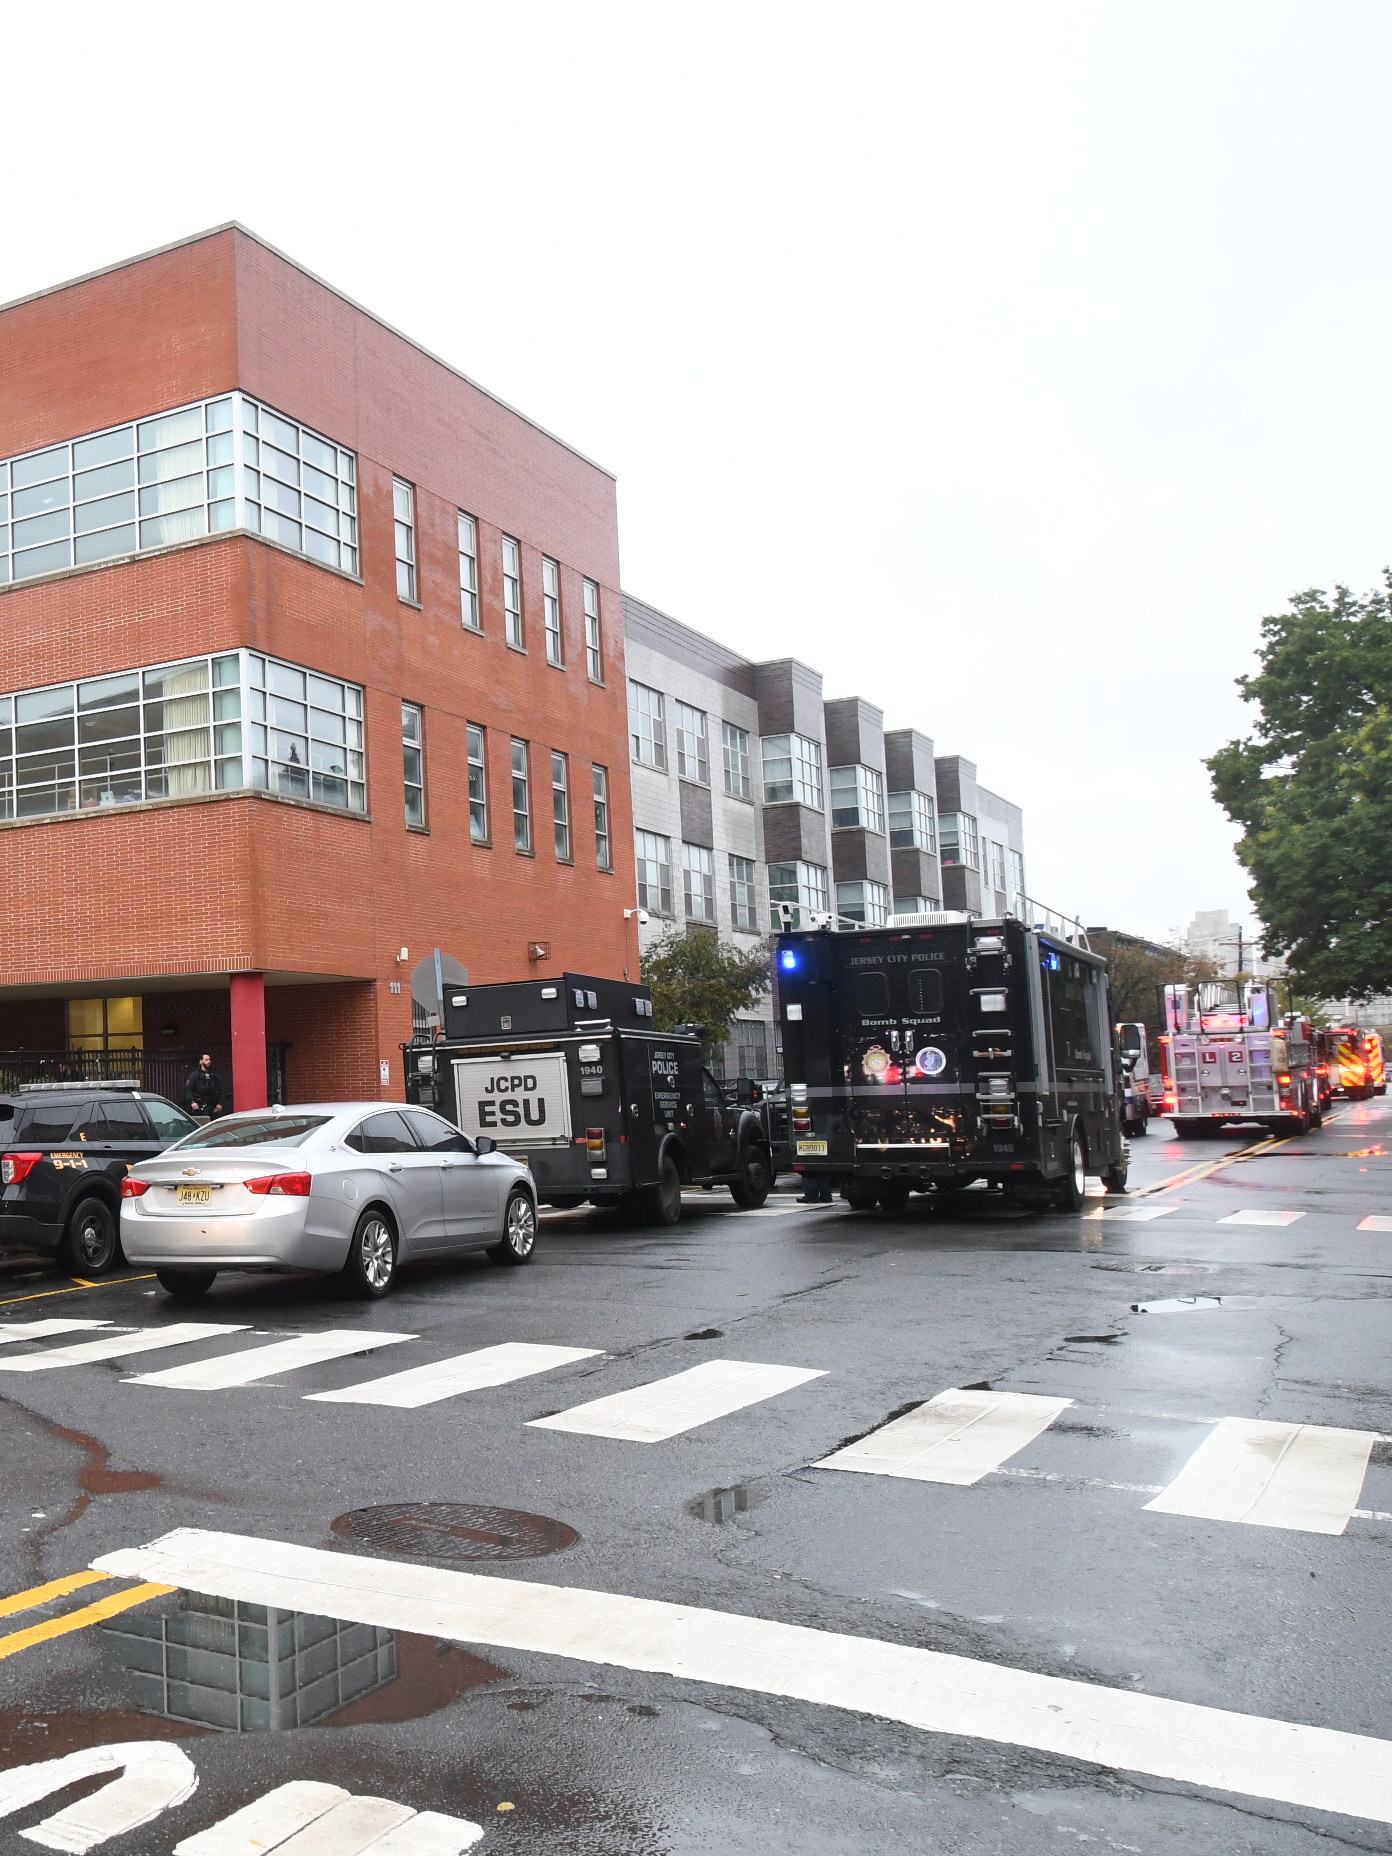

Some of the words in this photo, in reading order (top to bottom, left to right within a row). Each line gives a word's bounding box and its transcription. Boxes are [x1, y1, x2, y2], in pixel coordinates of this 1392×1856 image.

[849, 956, 884, 966] JERSEY
[887, 954, 908, 963] CITY
[911, 952, 945, 961] POLICE
[862, 1018, 897, 1026] Bomb
[902, 1016, 941, 1026] Squad
[1205, 1053, 1214, 1062] L
[1231, 1052, 1242, 1062] 2
[580, 1065, 603, 1075] 1940
[651, 1060, 679, 1075] POLICE
[484, 1075, 537, 1094] JCPD
[478, 1098, 546, 1128] ESU
[53, 1159, 89, 1170] 9-1-1
